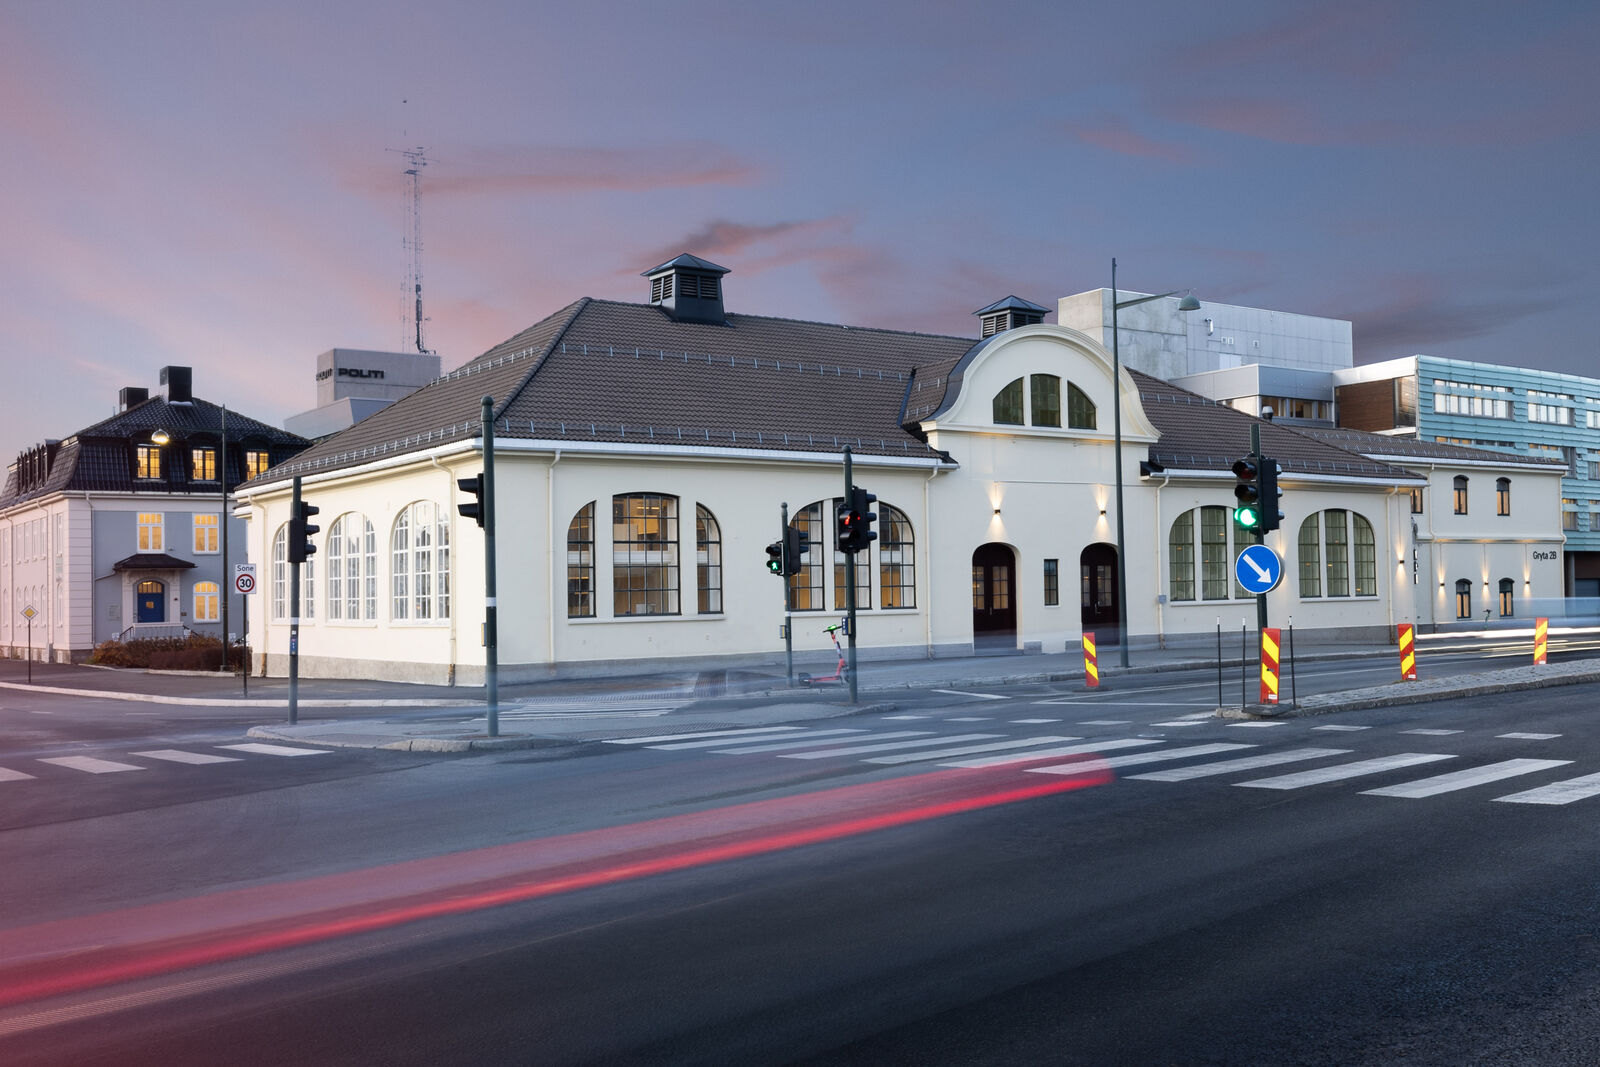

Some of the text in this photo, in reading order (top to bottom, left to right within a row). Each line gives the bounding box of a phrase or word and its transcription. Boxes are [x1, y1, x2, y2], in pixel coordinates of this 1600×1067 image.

[338, 368, 384, 379] POLITI
[1532, 551, 1548, 561] Gryta
[240, 578, 252, 588] 30
